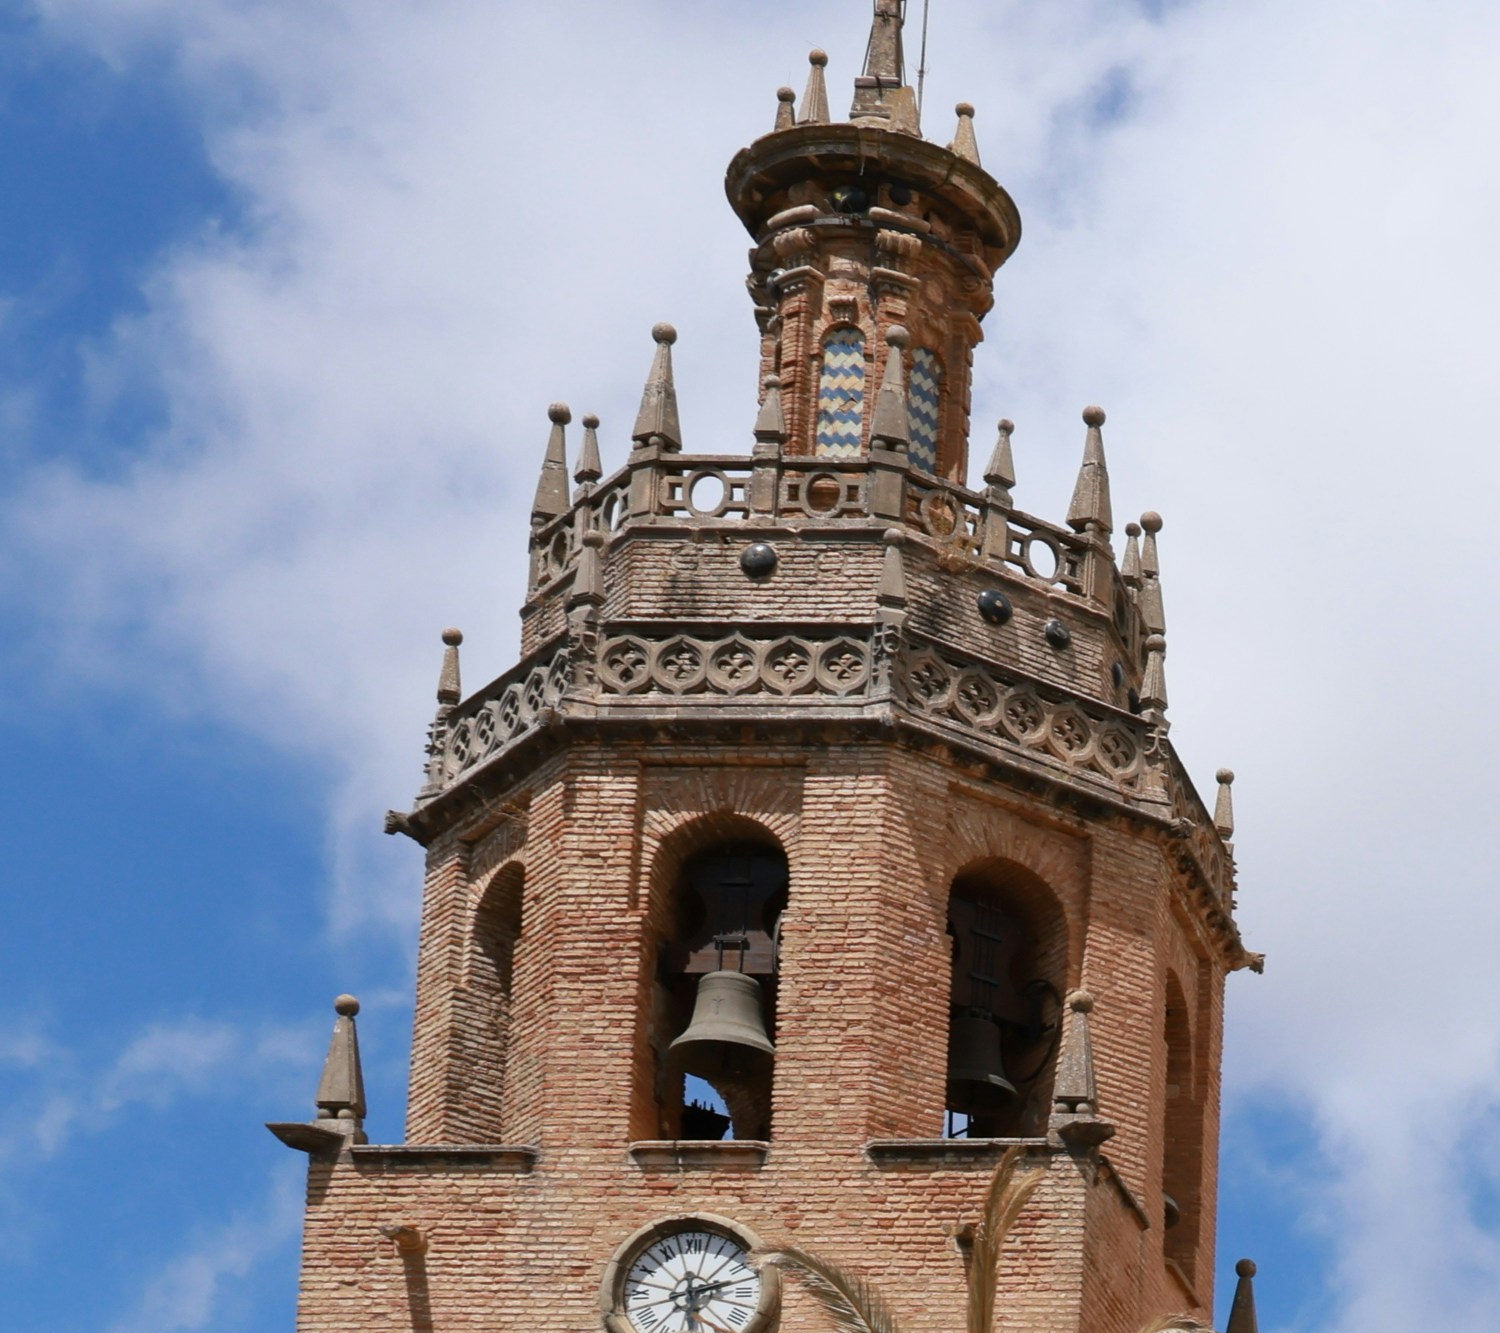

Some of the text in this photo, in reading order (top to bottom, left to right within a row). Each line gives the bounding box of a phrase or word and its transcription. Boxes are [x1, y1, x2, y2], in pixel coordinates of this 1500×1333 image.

[685, 1239, 702, 1254] XII
[659, 1244, 676, 1262] XI
[639, 1265, 657, 1278] X
[729, 1263, 747, 1275] II
[632, 1289, 650, 1300] IX
[735, 1287, 753, 1298] III
